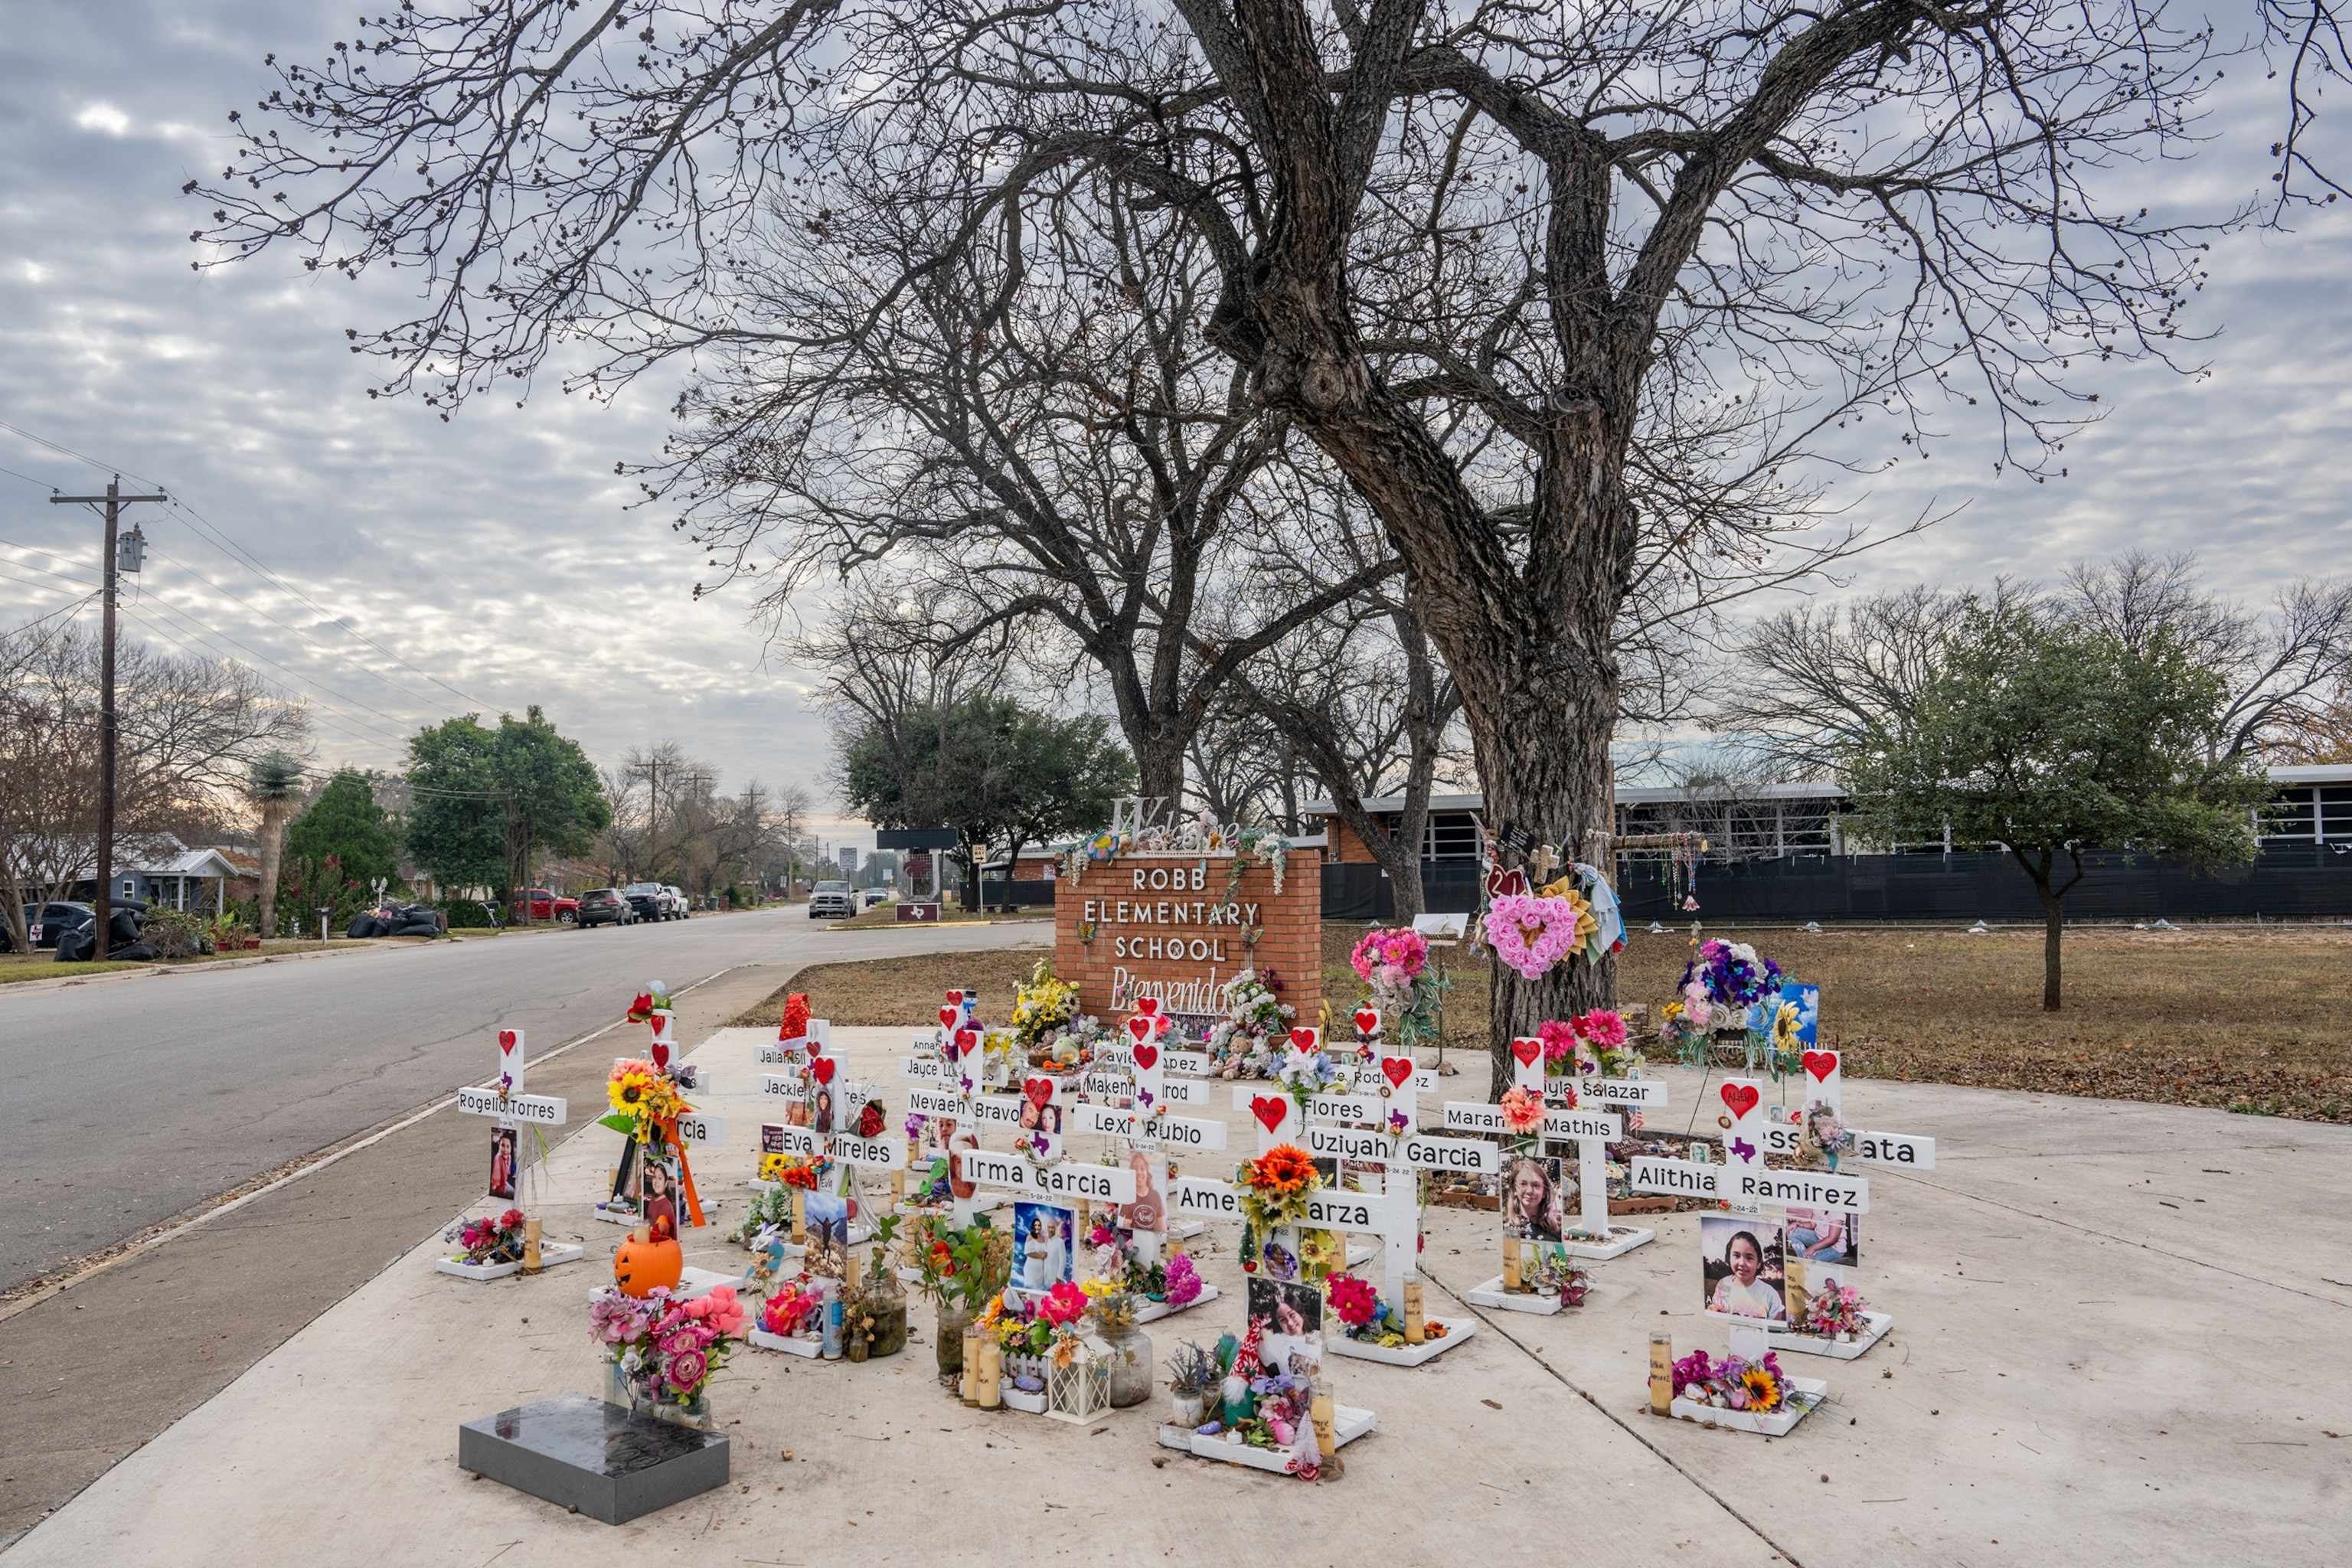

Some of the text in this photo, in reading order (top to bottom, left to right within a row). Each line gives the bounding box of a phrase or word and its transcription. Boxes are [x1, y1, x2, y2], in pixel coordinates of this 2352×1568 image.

[1133, 867, 1206, 891] ROBB
[1491, 871, 1517, 896] 21
[1084, 900, 1259, 926] ELEMENTARY
[1115, 936, 1226, 962] SCHOOL
[1109, 966, 1235, 1016] Bienvenido
[907, 1060, 937, 1078] Jayce
[1107, 1051, 1132, 1063] avie
[765, 1079, 804, 1097] Jackie
[1086, 1077, 1187, 1100] Makenn lrod
[1583, 1082, 1649, 1100] Salazar
[460, 1093, 554, 1119] Rogelio Torres
[911, 1094, 965, 1115] Nevaeh
[975, 1102, 1019, 1122] Bravo
[1304, 1099, 1363, 1118] Flores
[677, 1119, 706, 1140] rcia
[1096, 1113, 1200, 1143] Lexi Rubio
[1448, 1110, 1610, 1135] Maran Mathis
[784, 1132, 890, 1163] Eva Mireles
[1312, 1132, 1481, 1168] Uziyah Garcia
[1863, 1139, 1915, 1163] ata
[969, 1157, 1112, 1196] Irma Garcia
[1638, 1166, 1858, 1207] Alithia Ramirez
[1030, 1192, 1053, 1202] 5-24-22
[1308, 1202, 1370, 1225] arza
